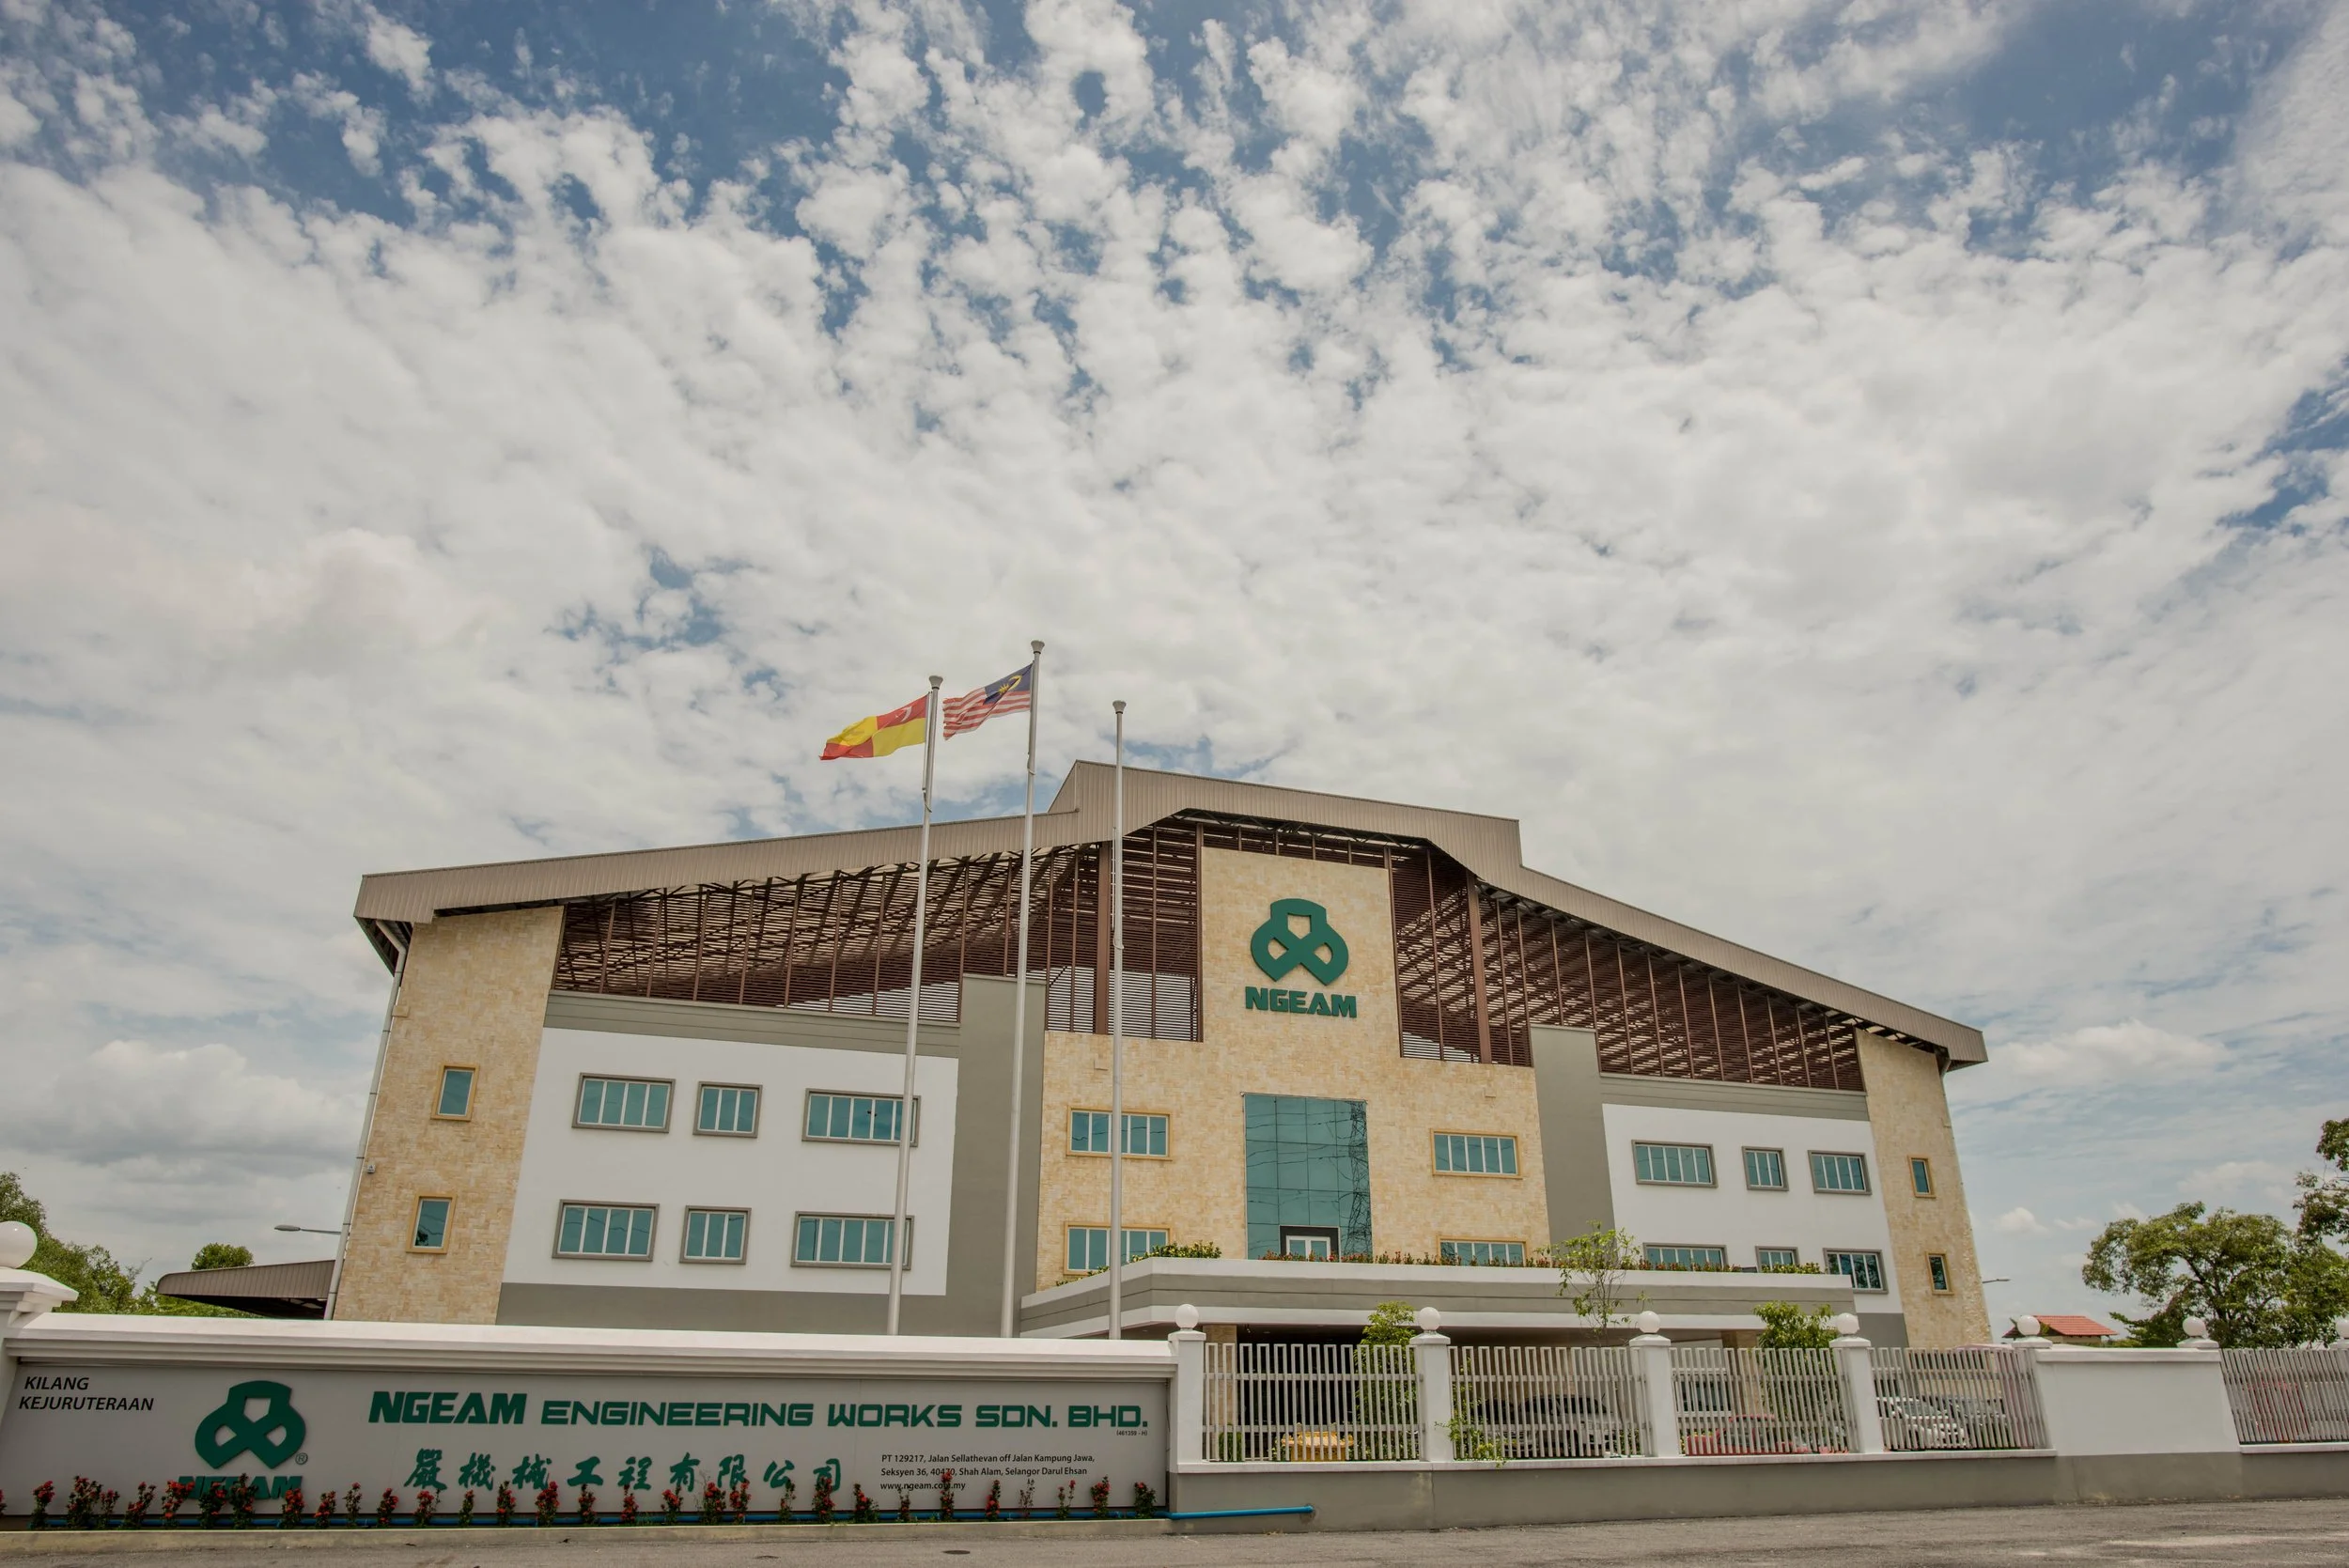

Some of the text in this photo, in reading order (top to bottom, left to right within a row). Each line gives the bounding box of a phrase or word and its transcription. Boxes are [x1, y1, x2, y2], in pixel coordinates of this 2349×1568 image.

[1245, 986, 1357, 1018] NGEAM
[24, 1376, 89, 1390] KILANG
[19, 1396, 154, 1411] KEJURUTERAAN
[368, 1391, 1148, 1427] NGEAM ENGINEERING WORKS SDN. BHD.
[881, 1454, 1095, 1464] PT 129217, Jalan Sellathevan off Jalan Kampung Jawa,
[880, 1467, 914, 1478] Seksyen
[916, 1467, 928, 1477] 36,
[959, 1467, 979, 1476] Shah
[981, 1467, 1003, 1477] Alam,
[1005, 1467, 1040, 1477] Selangor
